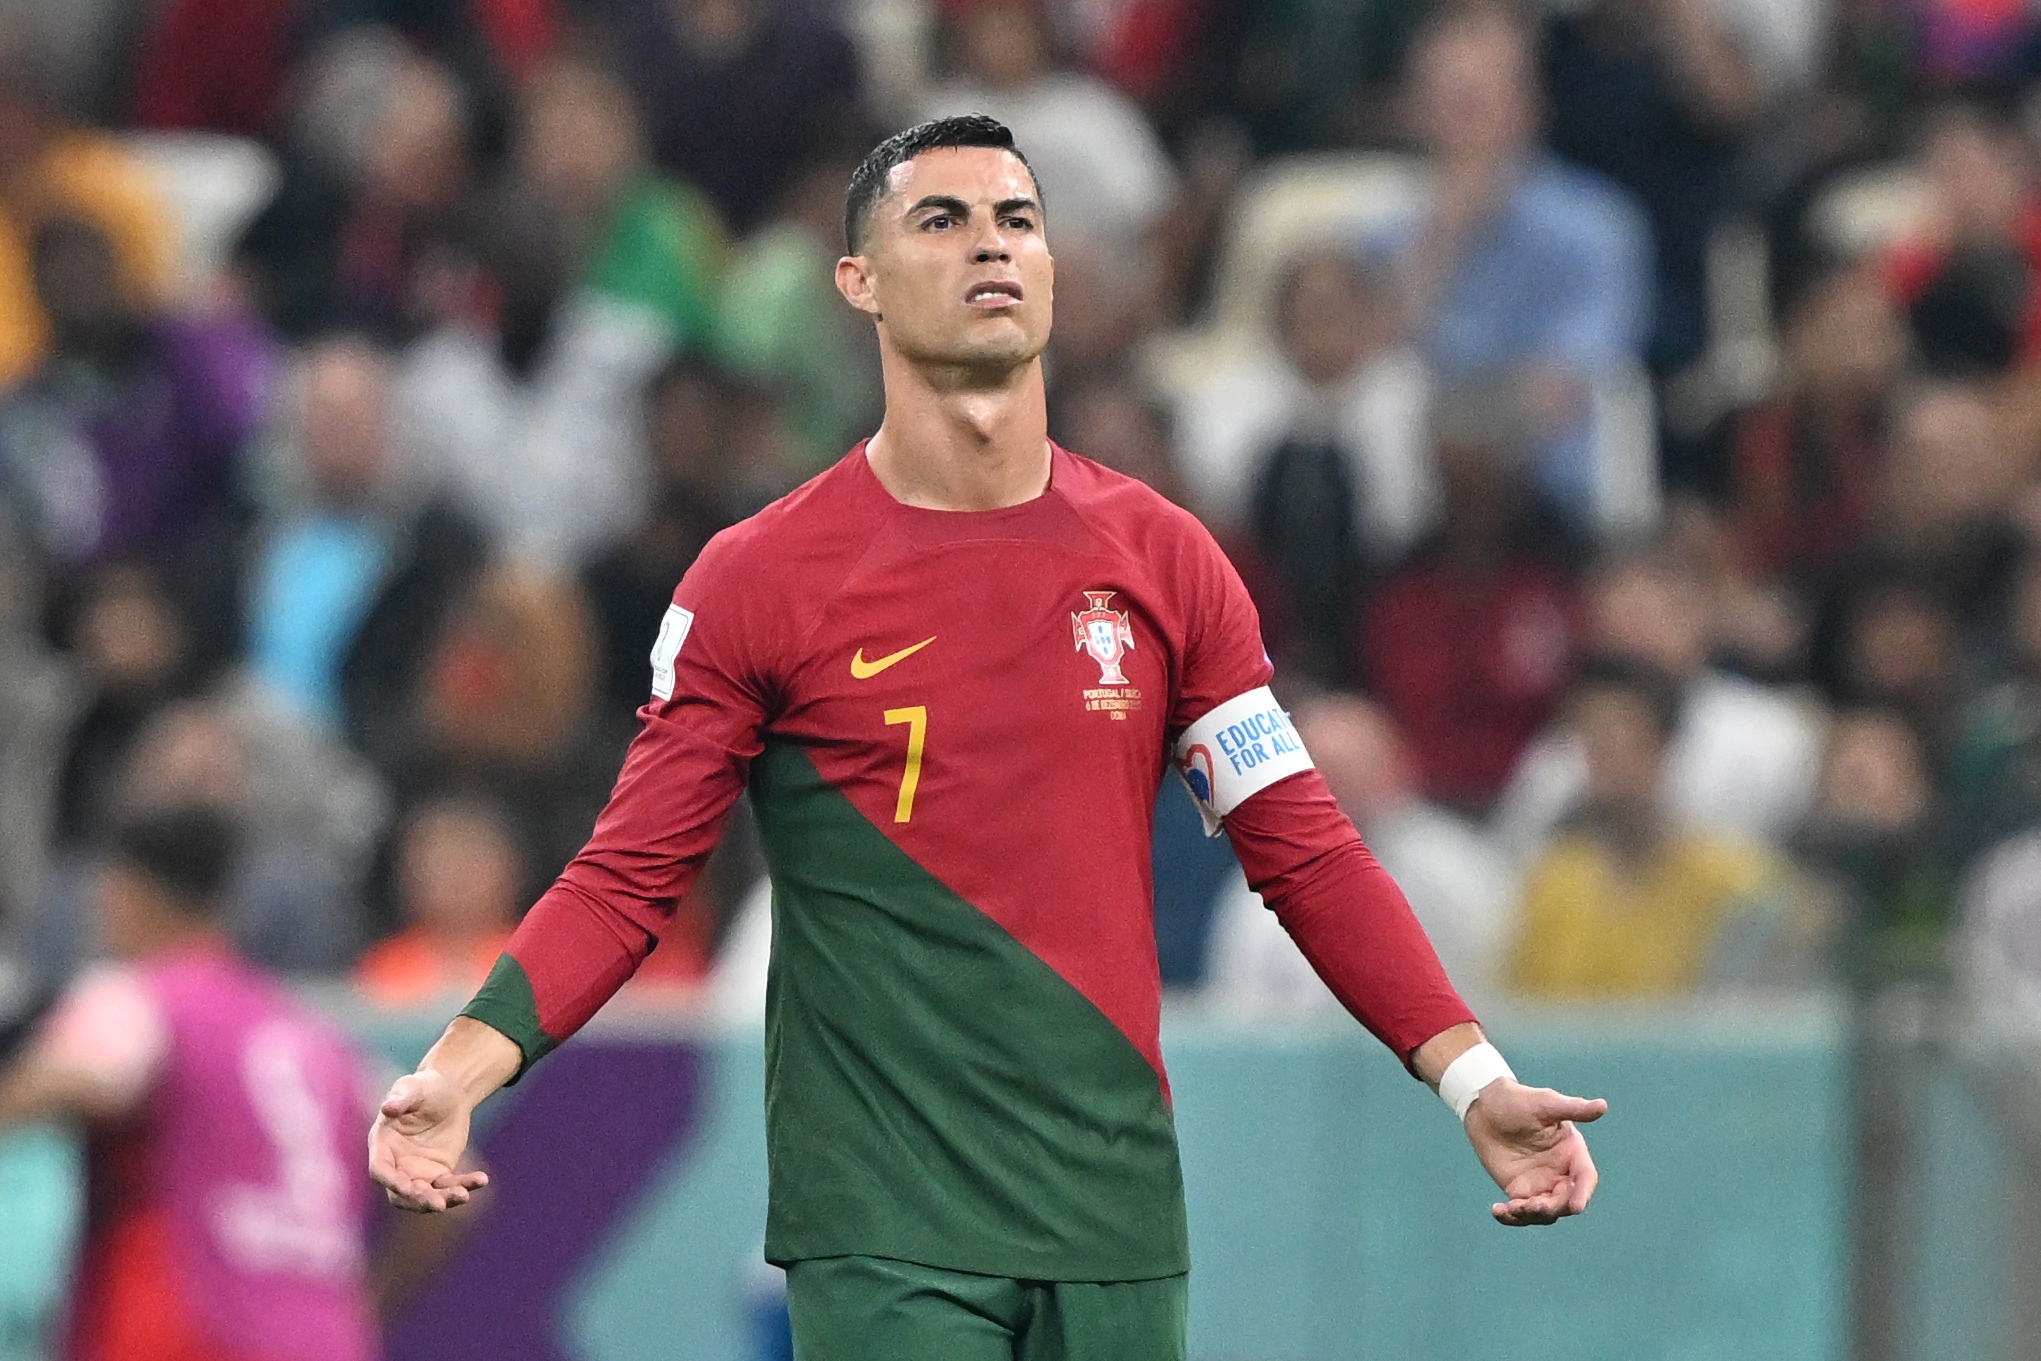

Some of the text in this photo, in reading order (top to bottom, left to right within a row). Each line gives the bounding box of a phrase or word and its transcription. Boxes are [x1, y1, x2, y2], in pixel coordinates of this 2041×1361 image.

[884, 705, 927, 823] 7
[1229, 730, 1300, 777] FOR ALL
